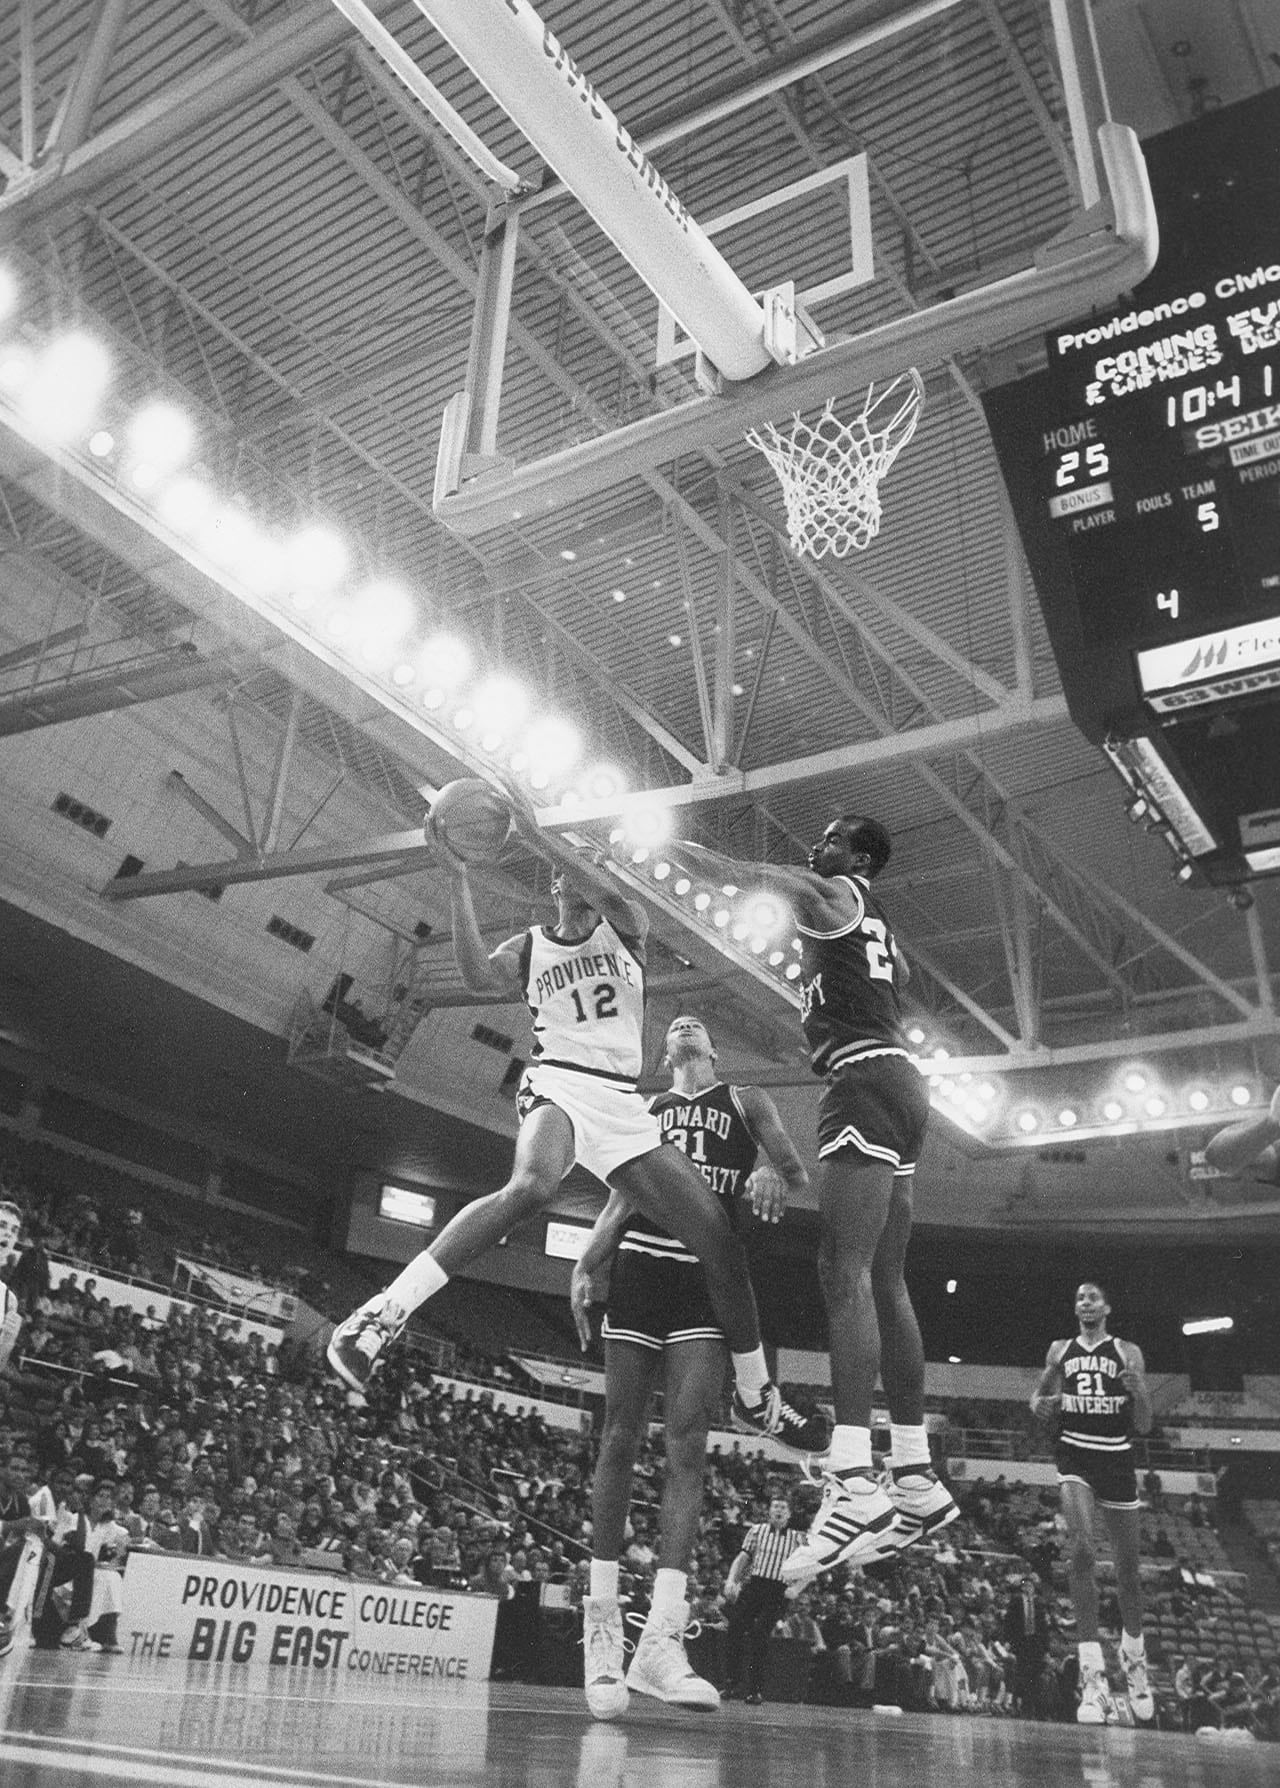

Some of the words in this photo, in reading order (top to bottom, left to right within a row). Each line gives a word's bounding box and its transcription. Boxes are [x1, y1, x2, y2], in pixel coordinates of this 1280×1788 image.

[1226, 299, 1280, 337] EV
[1043, 418, 1098, 451] HOME
[1056, 442, 1109, 487] 25
[1233, 444, 1258, 461] TIME
[1239, 459, 1280, 484] PERIO
[1060, 488, 1102, 512] BONUS
[1136, 492, 1172, 514] FOULS
[1181, 479, 1216, 500] TEAM
[1073, 509, 1117, 533] PLAYER
[1198, 502, 1219, 532] 5
[1156, 588, 1179, 619] 4
[861, 916, 897, 984] 2
[535, 953, 634, 1005] PROVIDENE
[571, 983, 618, 1022] 12
[667, 1128, 707, 1162] 31
[1064, 1355, 1118, 1378] HOWARD
[1076, 1372, 1106, 1396] 21
[182, 1575, 347, 1620] PROVIDENCE
[359, 1594, 454, 1631] COLLEGE
[129, 1630, 175, 1658] THE
[187, 1617, 257, 1664] BIG
[269, 1624, 350, 1669] EAST
[347, 1648, 468, 1679] CONFERENCE
